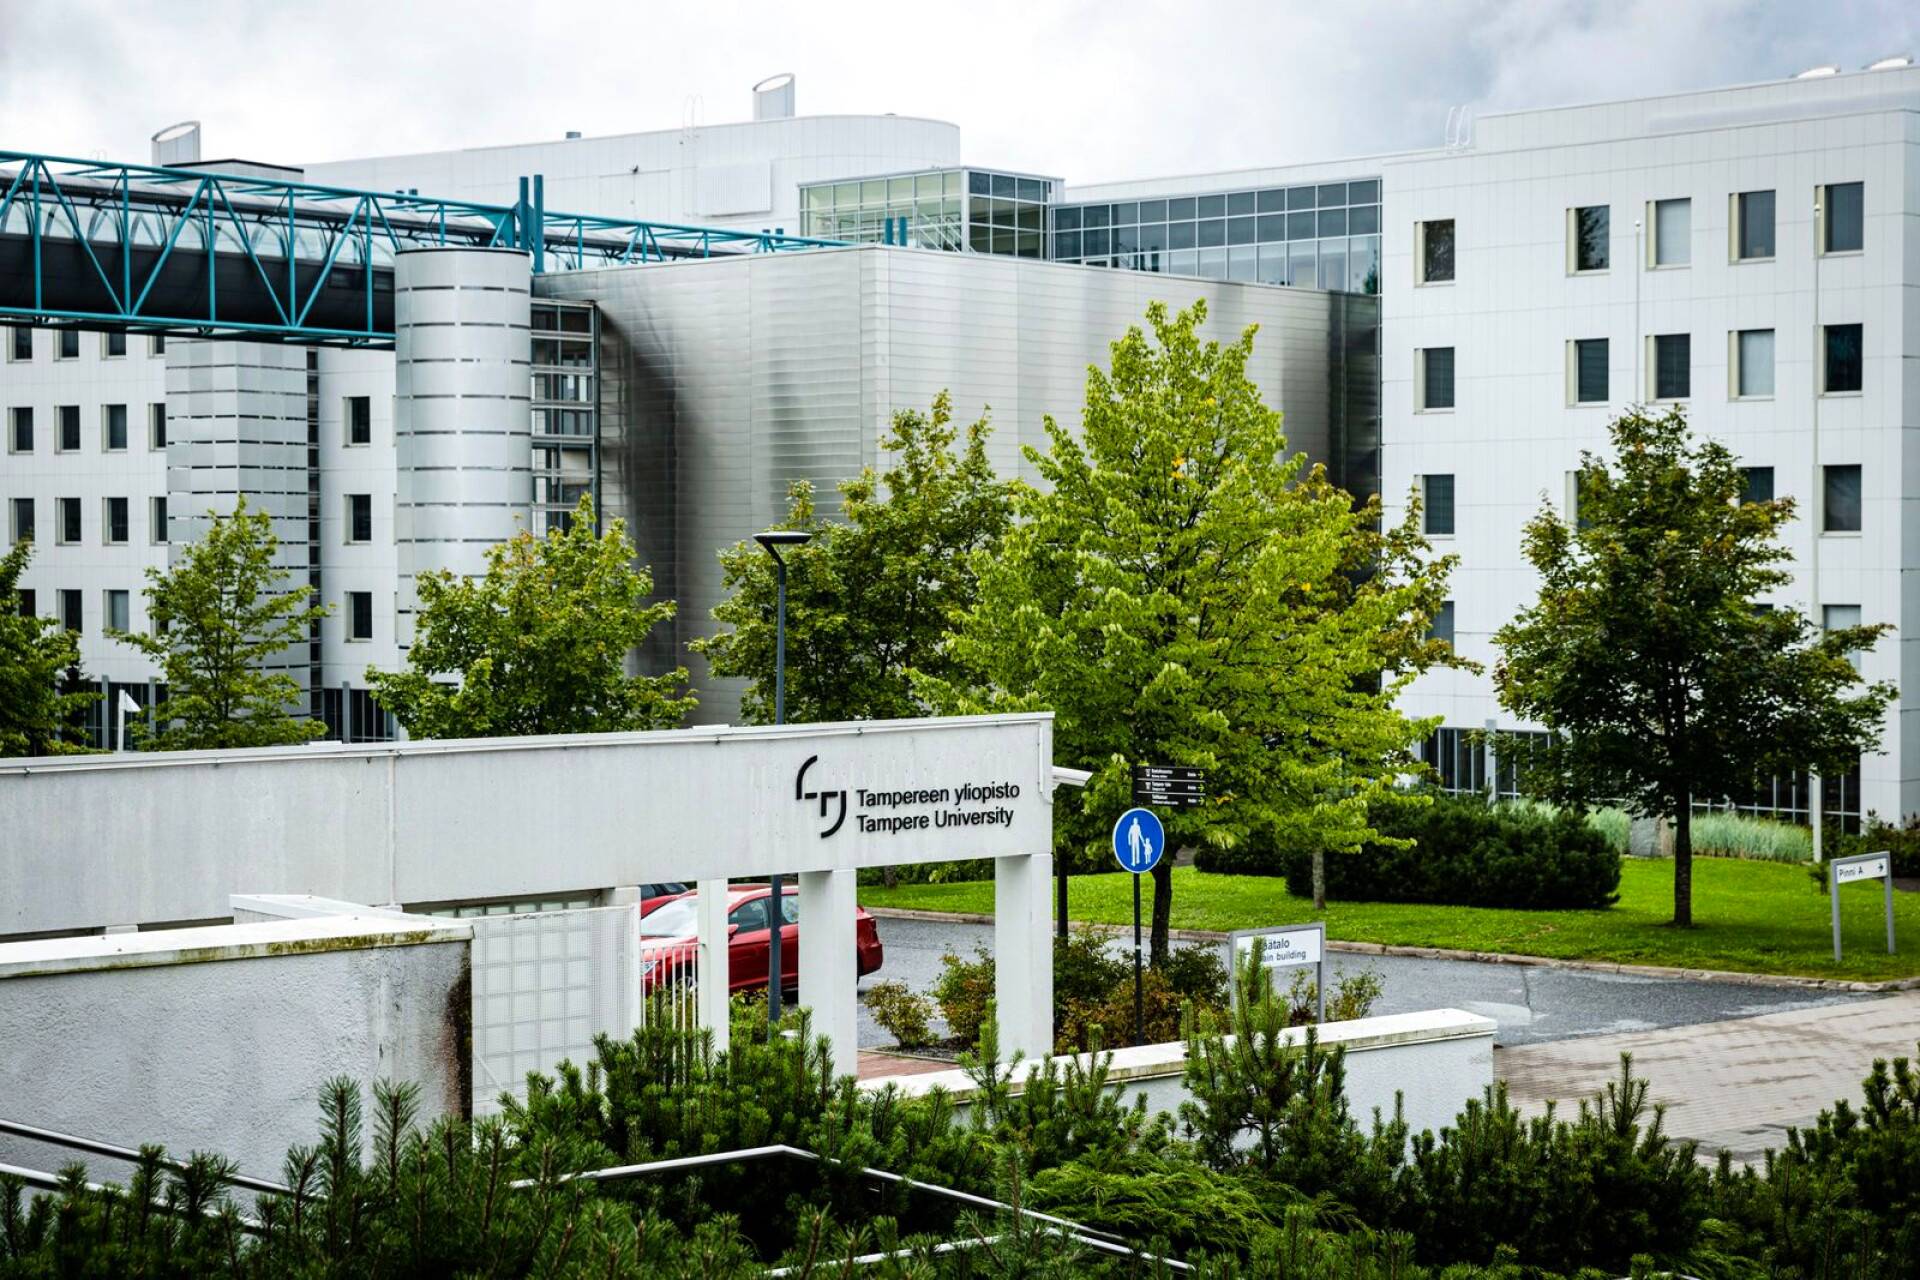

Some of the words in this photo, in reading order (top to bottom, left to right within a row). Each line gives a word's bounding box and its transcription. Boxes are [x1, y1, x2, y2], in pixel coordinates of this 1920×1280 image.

[856, 788, 949, 809] Tampereen
[954, 781, 1020, 805] yliopisto
[856, 814, 929, 834] Tampere
[935, 807, 1014, 828] University
[1858, 865, 1864, 874] A
[1276, 950, 1307, 962] building
